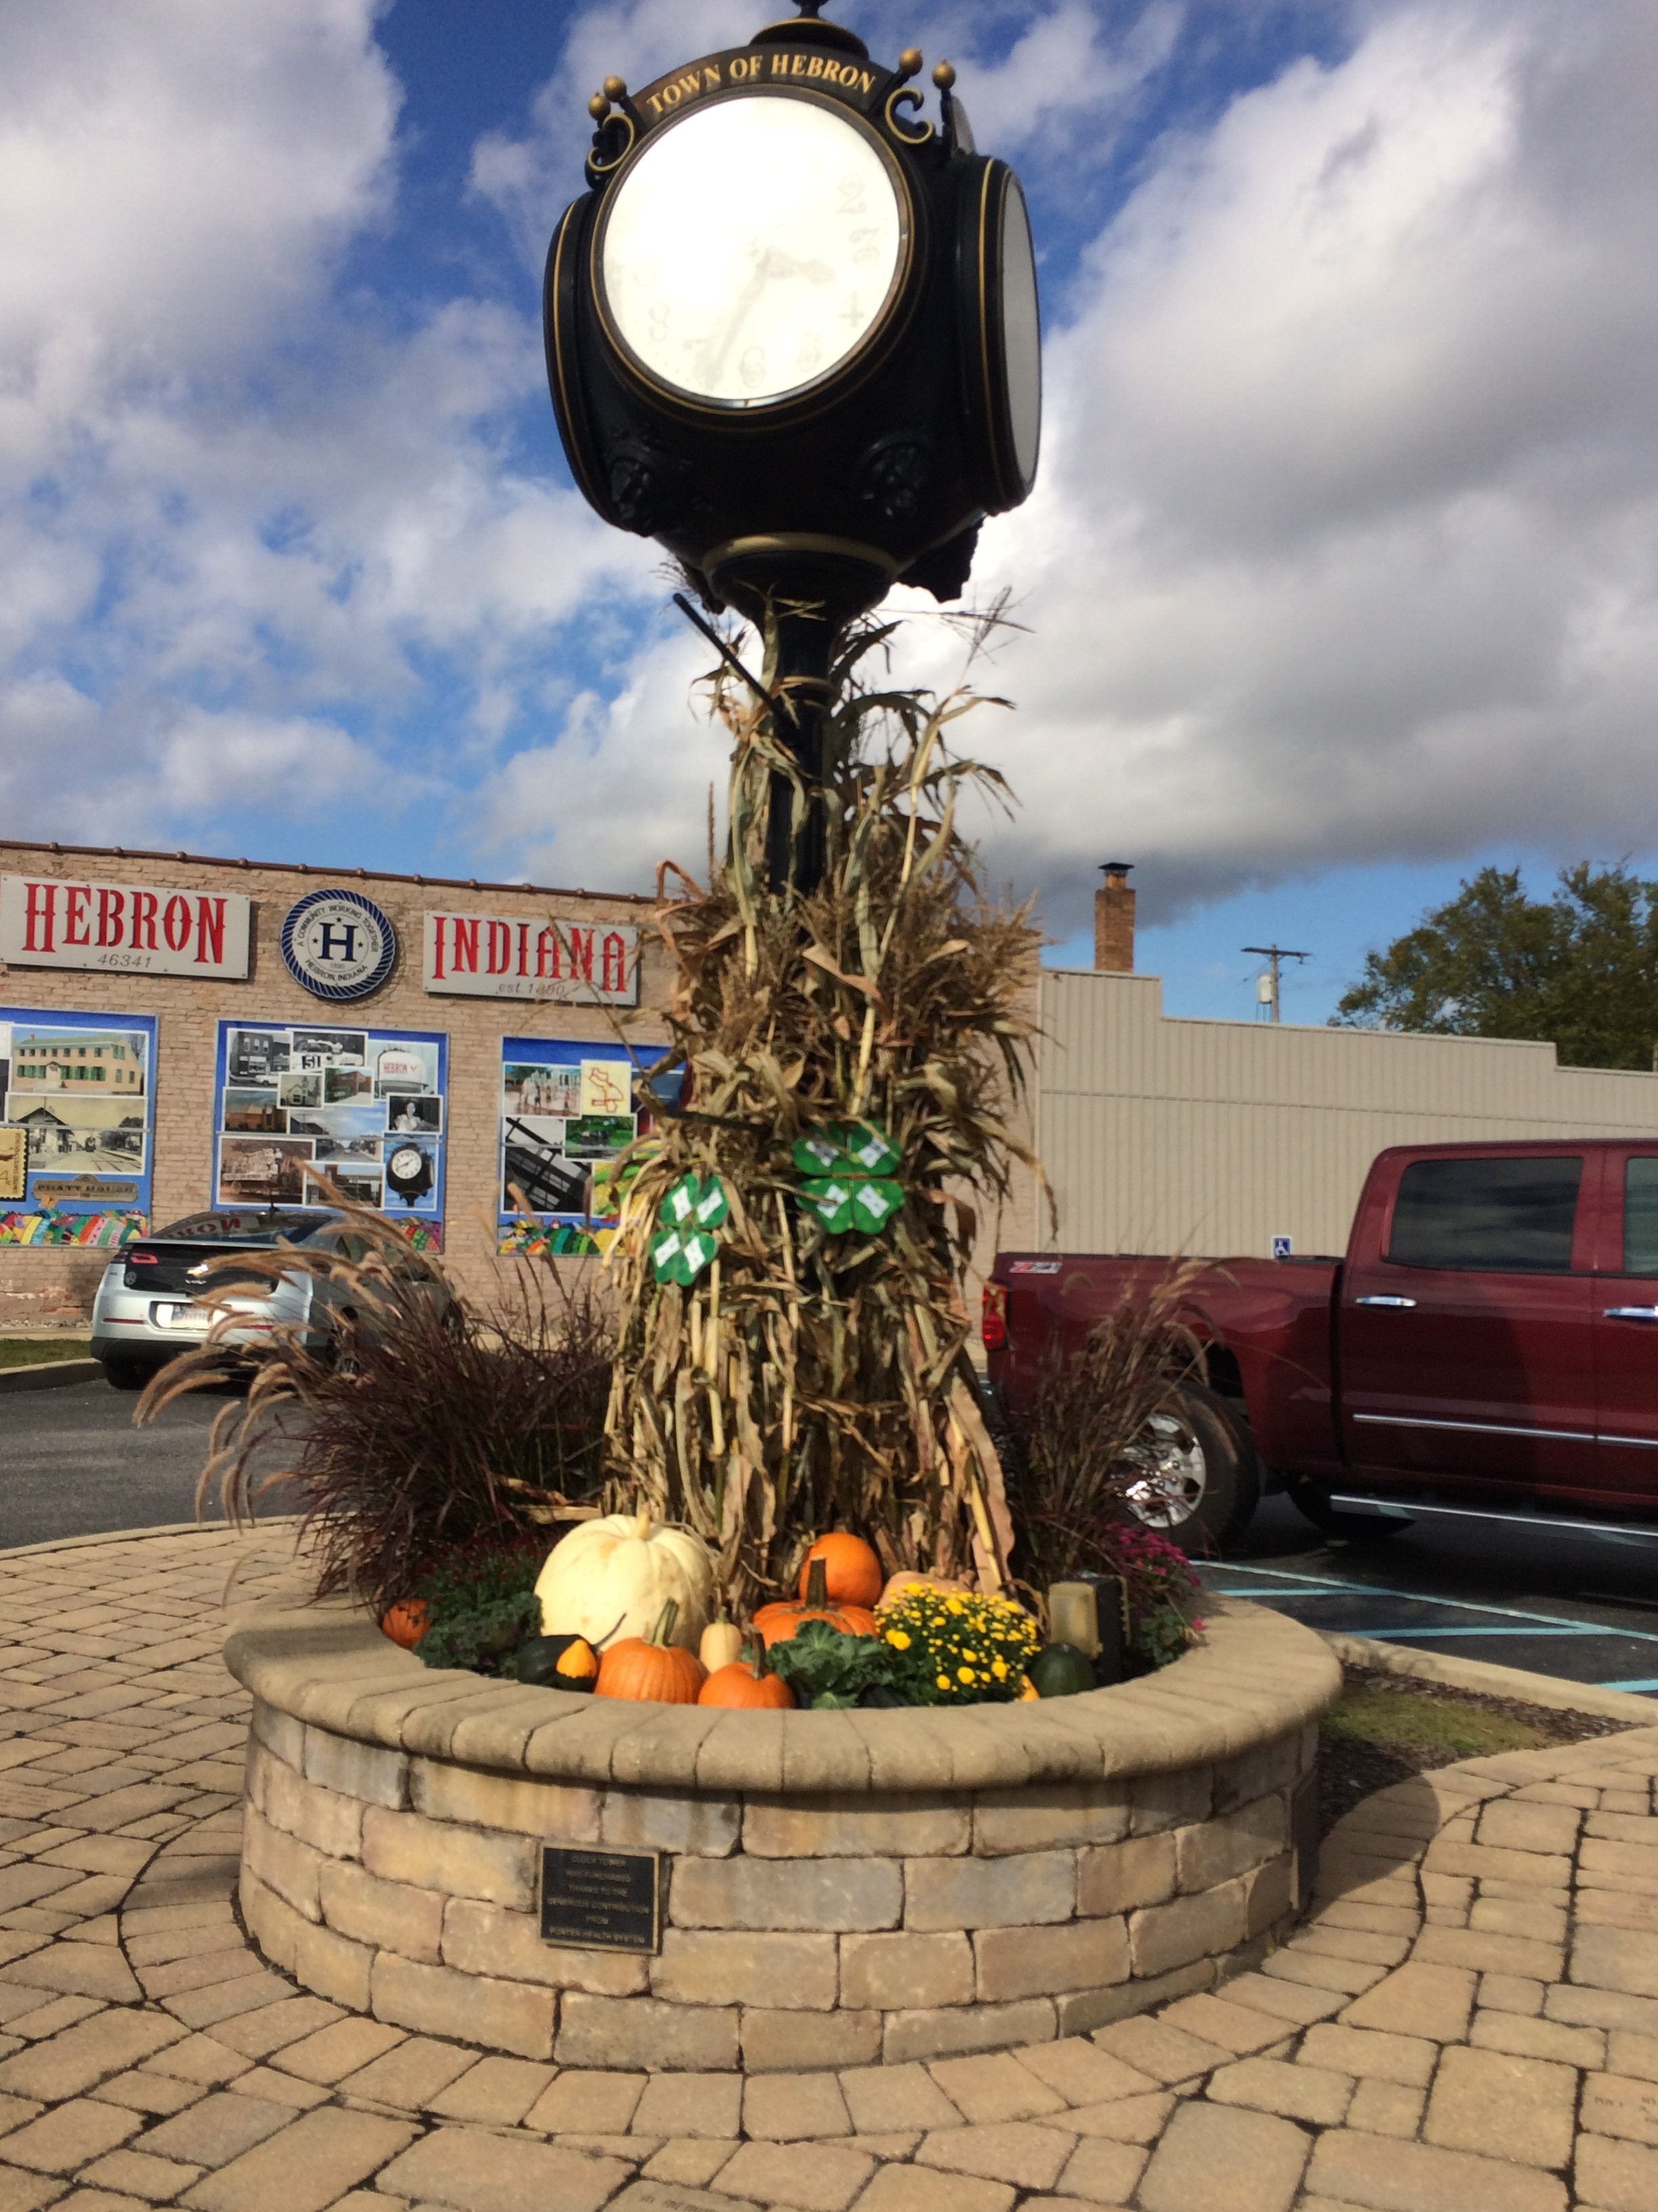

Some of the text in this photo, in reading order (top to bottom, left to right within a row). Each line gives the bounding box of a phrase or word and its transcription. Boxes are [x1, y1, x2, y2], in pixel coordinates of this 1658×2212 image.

[646, 54, 877, 113] TOWN OF HEBRON
[21, 883, 228, 964] HEBRON
[297, 907, 326, 939] COMMUNITY
[329, 905, 362, 920] WORKING
[362, 917, 379, 953] TOGETHER
[317, 922, 359, 962] H
[98, 954, 152, 968] 46341
[338, 965, 369, 981] INDIANA
[432, 916, 627, 992] INDIANA
[304, 1056, 321, 1069] 51
